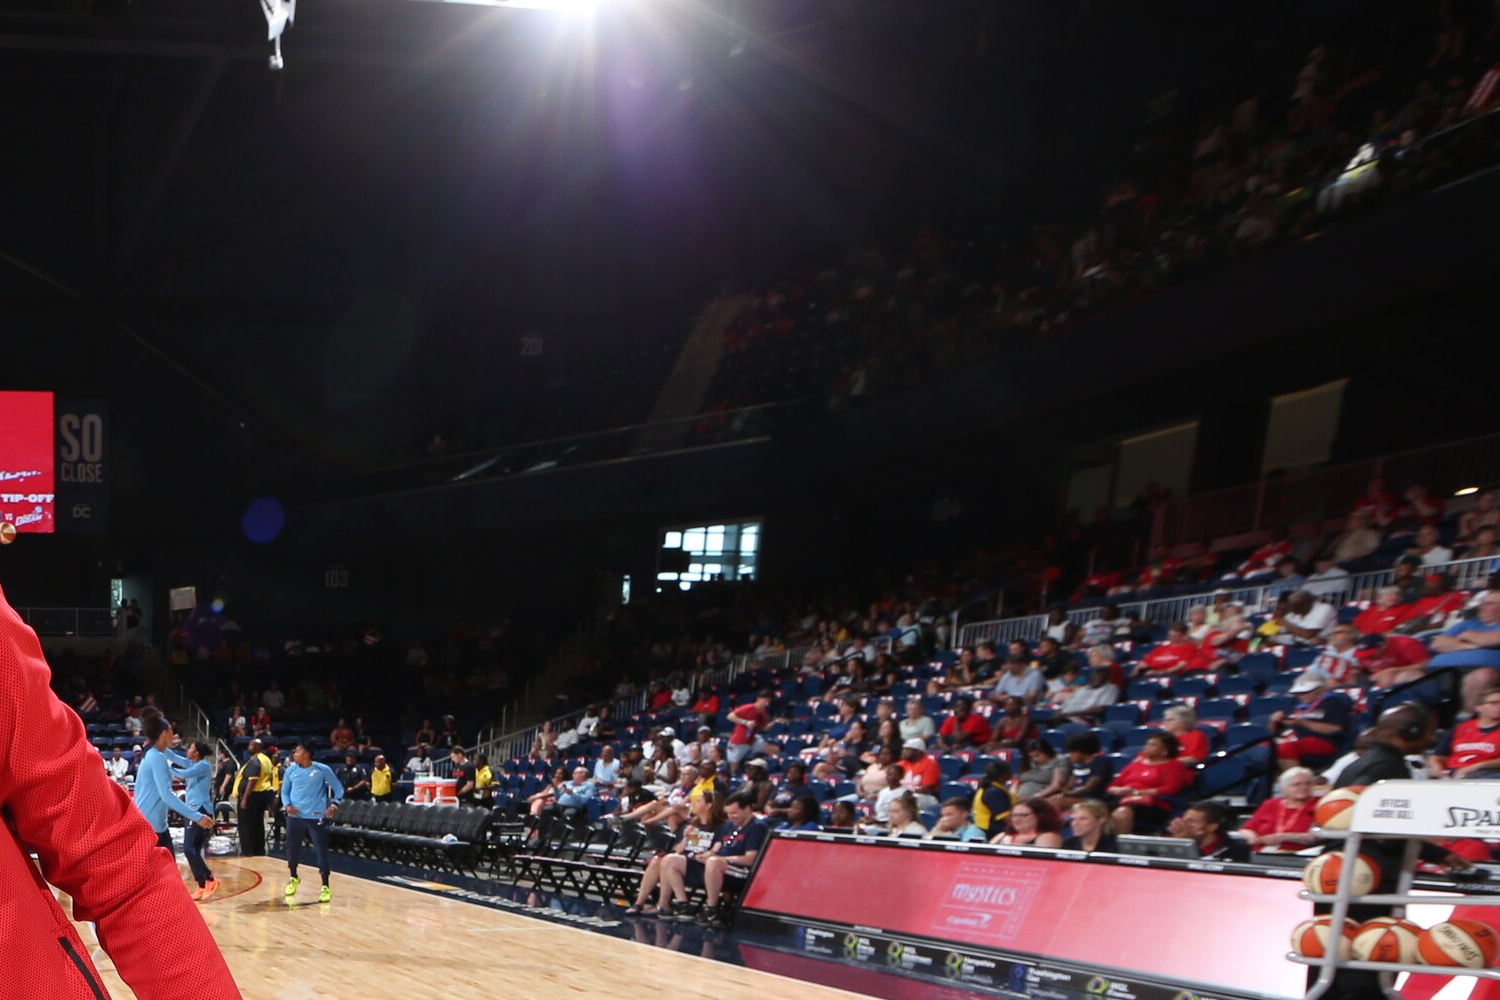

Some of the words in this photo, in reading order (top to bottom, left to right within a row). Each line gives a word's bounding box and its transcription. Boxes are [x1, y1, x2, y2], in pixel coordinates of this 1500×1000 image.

[60, 413, 103, 462] SO
[61, 462, 103, 483] CLOSE
[1, 494, 54, 504] TIP-OFF
[72, 506, 92, 518] DC
[325, 569, 348, 588] 103
[1444, 806, 1500, 829] SPA
